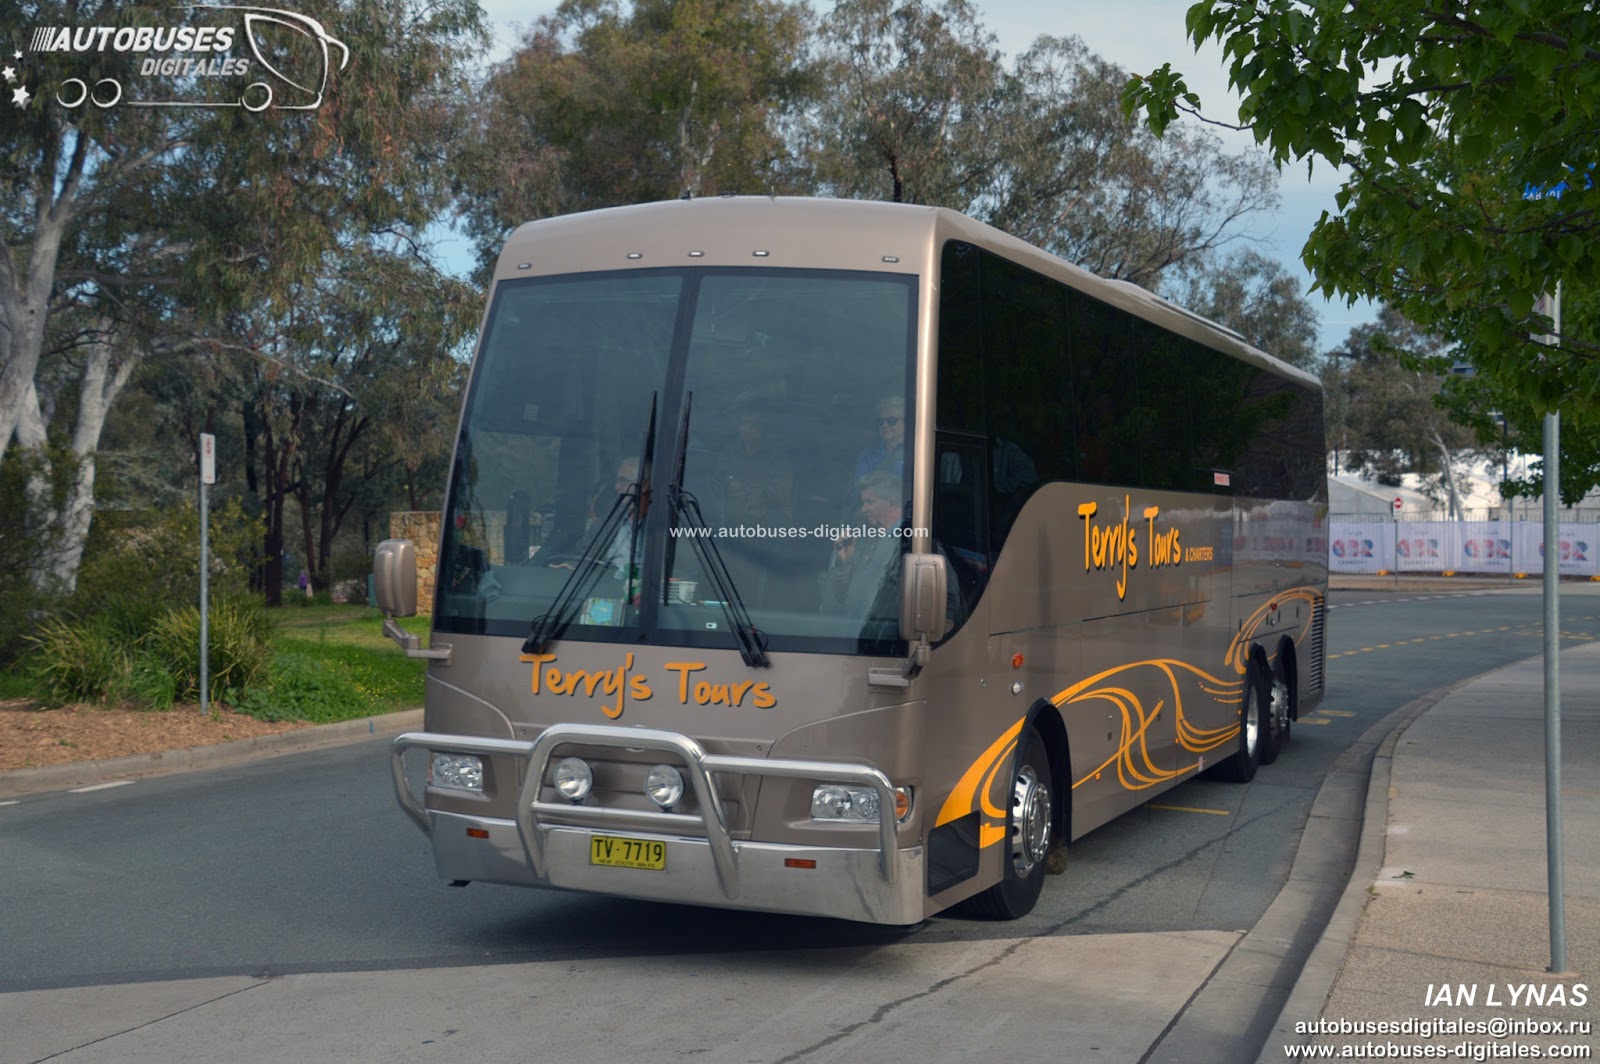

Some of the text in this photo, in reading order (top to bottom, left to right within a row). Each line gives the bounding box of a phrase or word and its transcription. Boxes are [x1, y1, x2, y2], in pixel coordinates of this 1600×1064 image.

[1077, 494, 1137, 600] Terry's
[1143, 505, 1181, 568] Tours
[519, 652, 777, 719] Terry's Tours
